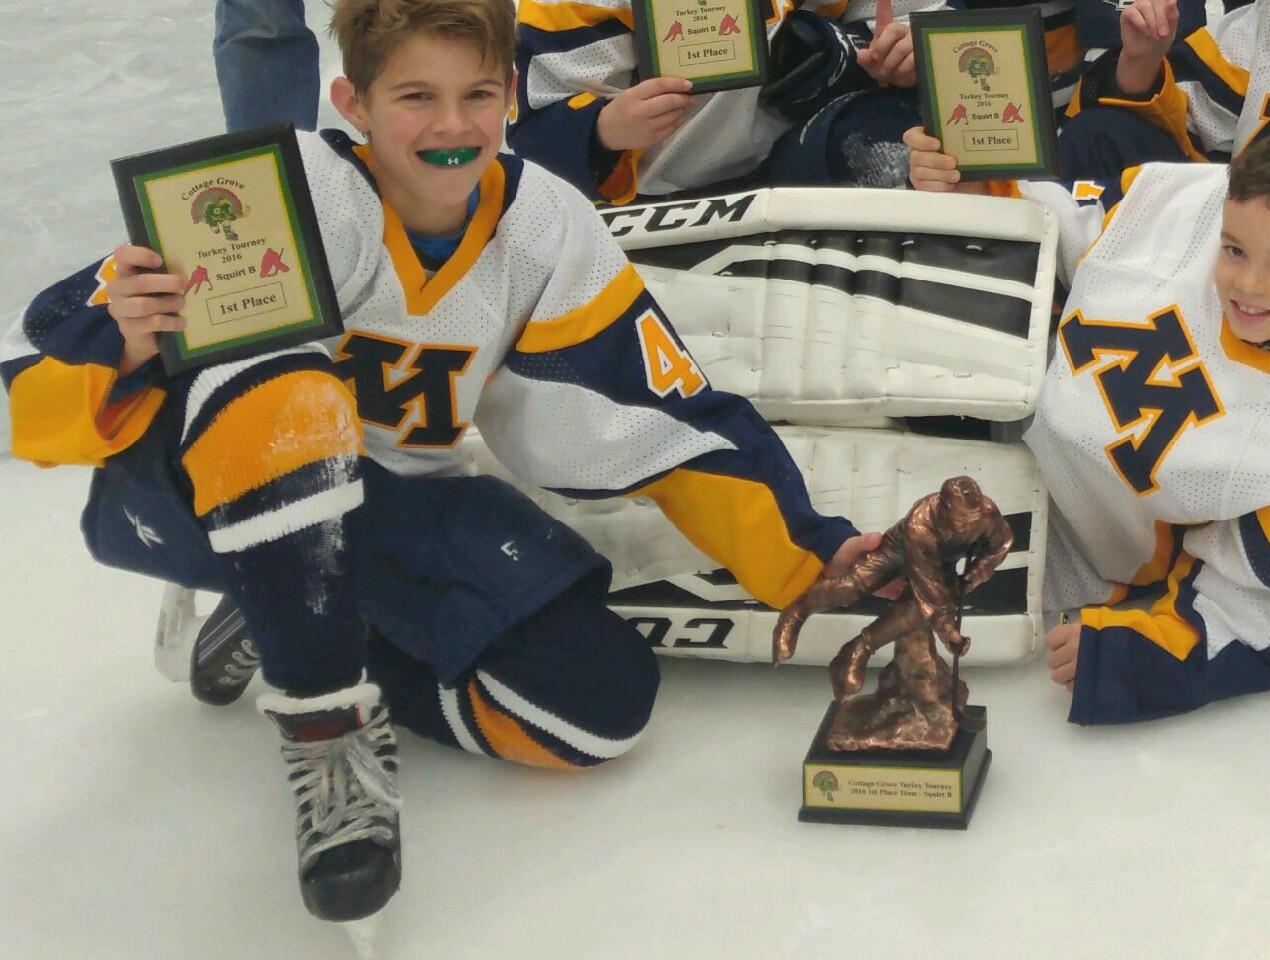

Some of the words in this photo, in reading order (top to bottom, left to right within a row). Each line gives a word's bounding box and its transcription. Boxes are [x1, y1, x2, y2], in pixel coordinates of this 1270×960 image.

[700, 6, 725, 15] Tourney
[688, 26, 710, 35] Squirt
[687, 51, 700, 59] 1st
[703, 48, 728, 58] Place
[953, 40, 977, 54] Cottage
[979, 40, 998, 53] Grove
[972, 113, 993, 121] Squirt
[972, 137, 985, 145] 1st
[988, 136, 1012, 145] Place
[181, 179, 215, 201] Cottage
[216, 177, 245, 191] Grove
[600, 192, 757, 239] CCM
[196, 246, 227, 260] Turkey
[231, 237, 266, 252] Tourney
[221, 253, 243, 264] 2016
[216, 268, 246, 282] Squirt
[219, 303, 239, 316] 1st
[242, 293, 277, 311] Place
[635, 308, 710, 400] 4
[1058, 303, 1226, 496] M
